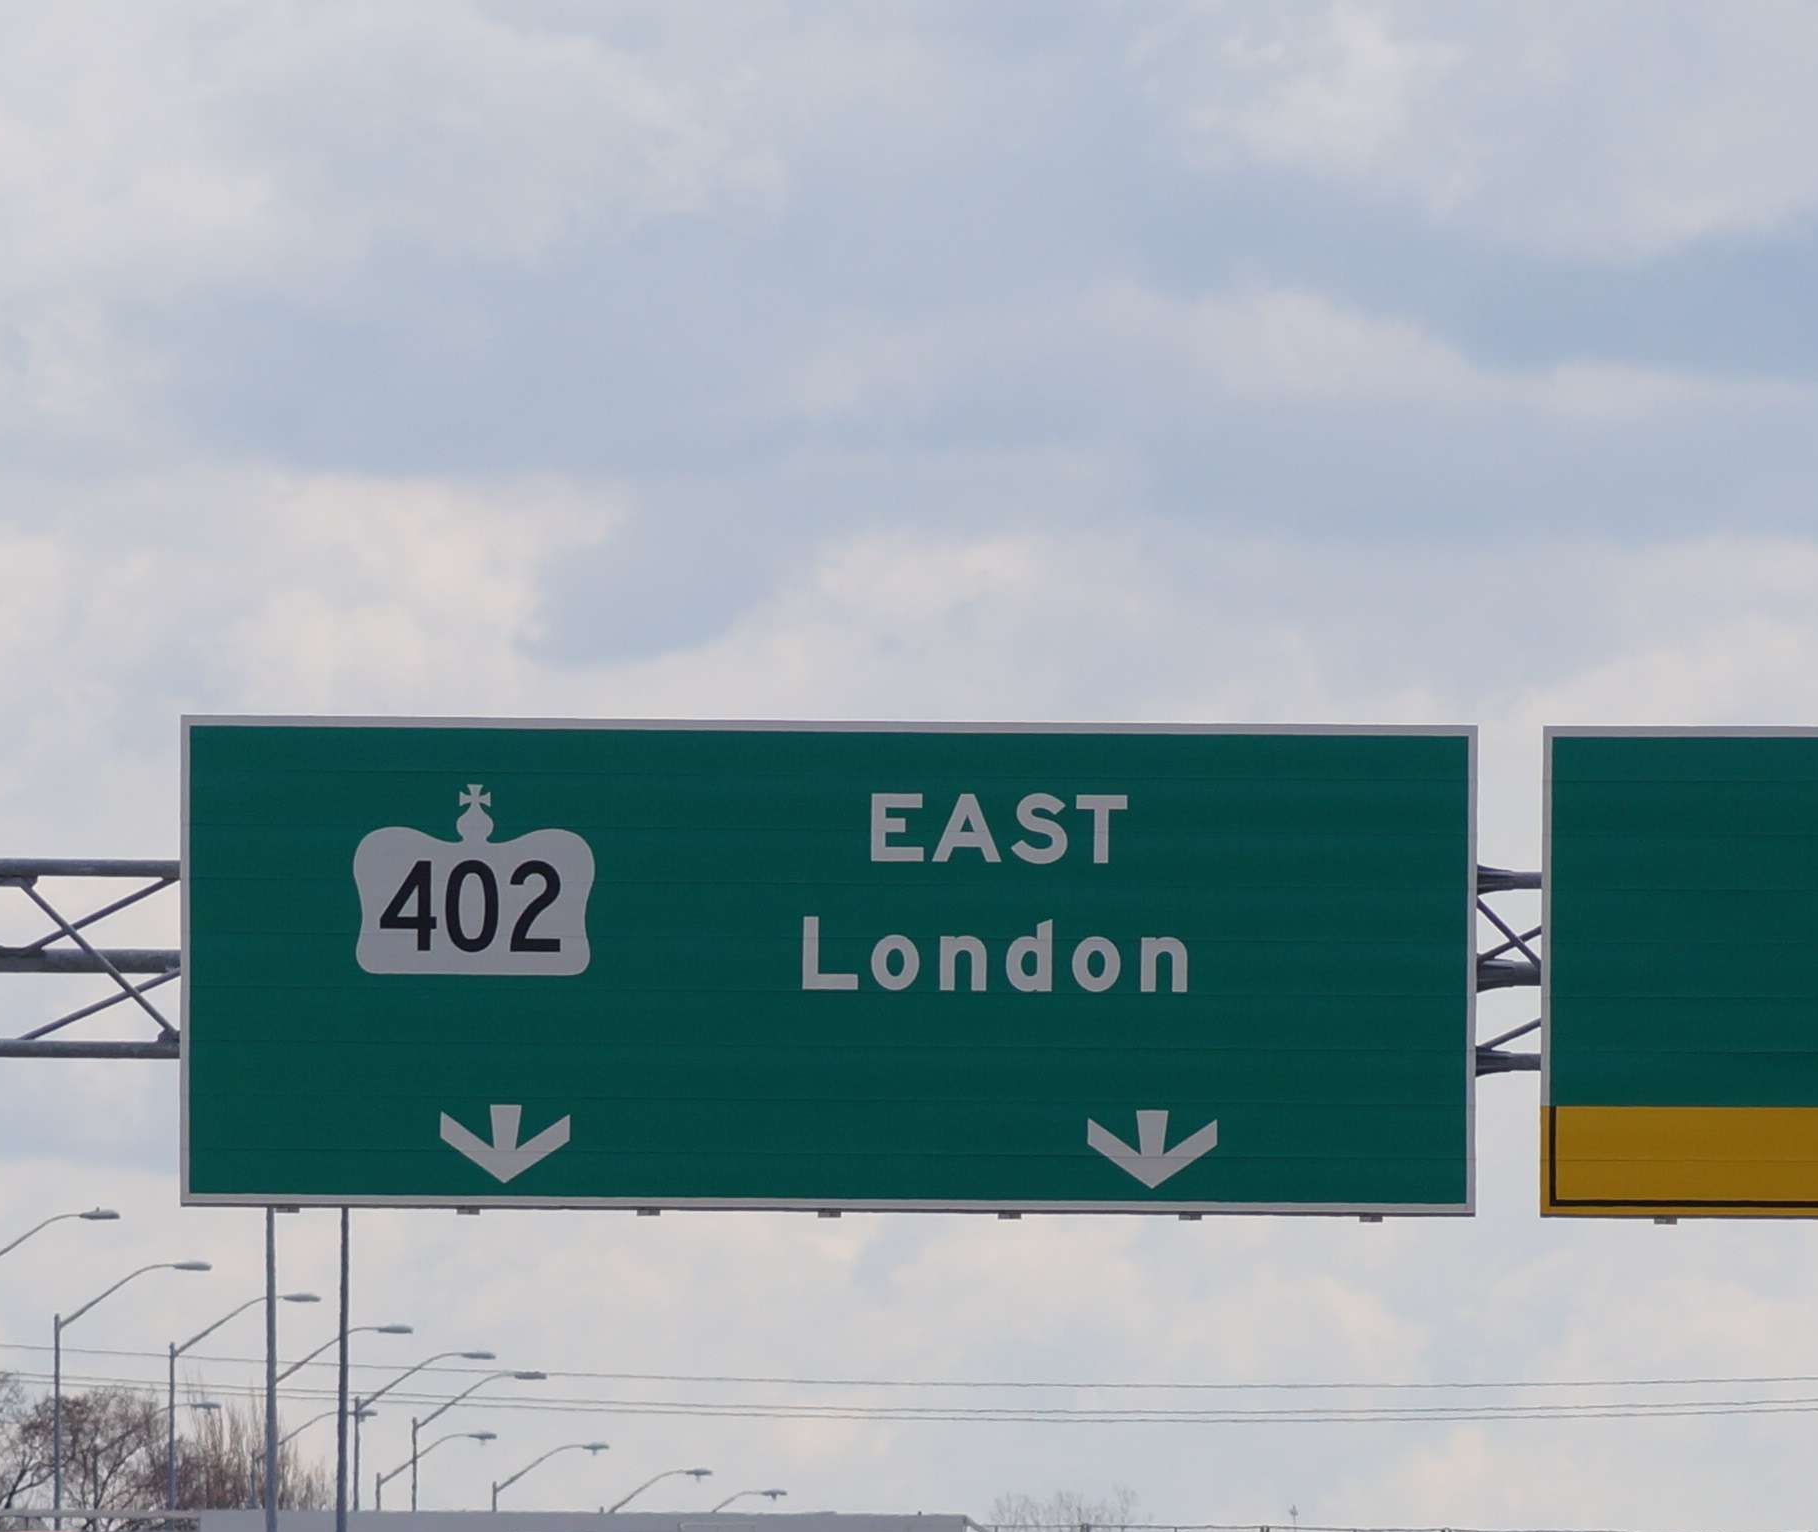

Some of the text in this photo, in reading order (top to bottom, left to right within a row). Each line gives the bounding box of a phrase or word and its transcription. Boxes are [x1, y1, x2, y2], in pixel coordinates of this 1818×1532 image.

[870, 792, 1129, 865] EAST
[379, 858, 563, 955] 402
[801, 915, 1189, 994] London
